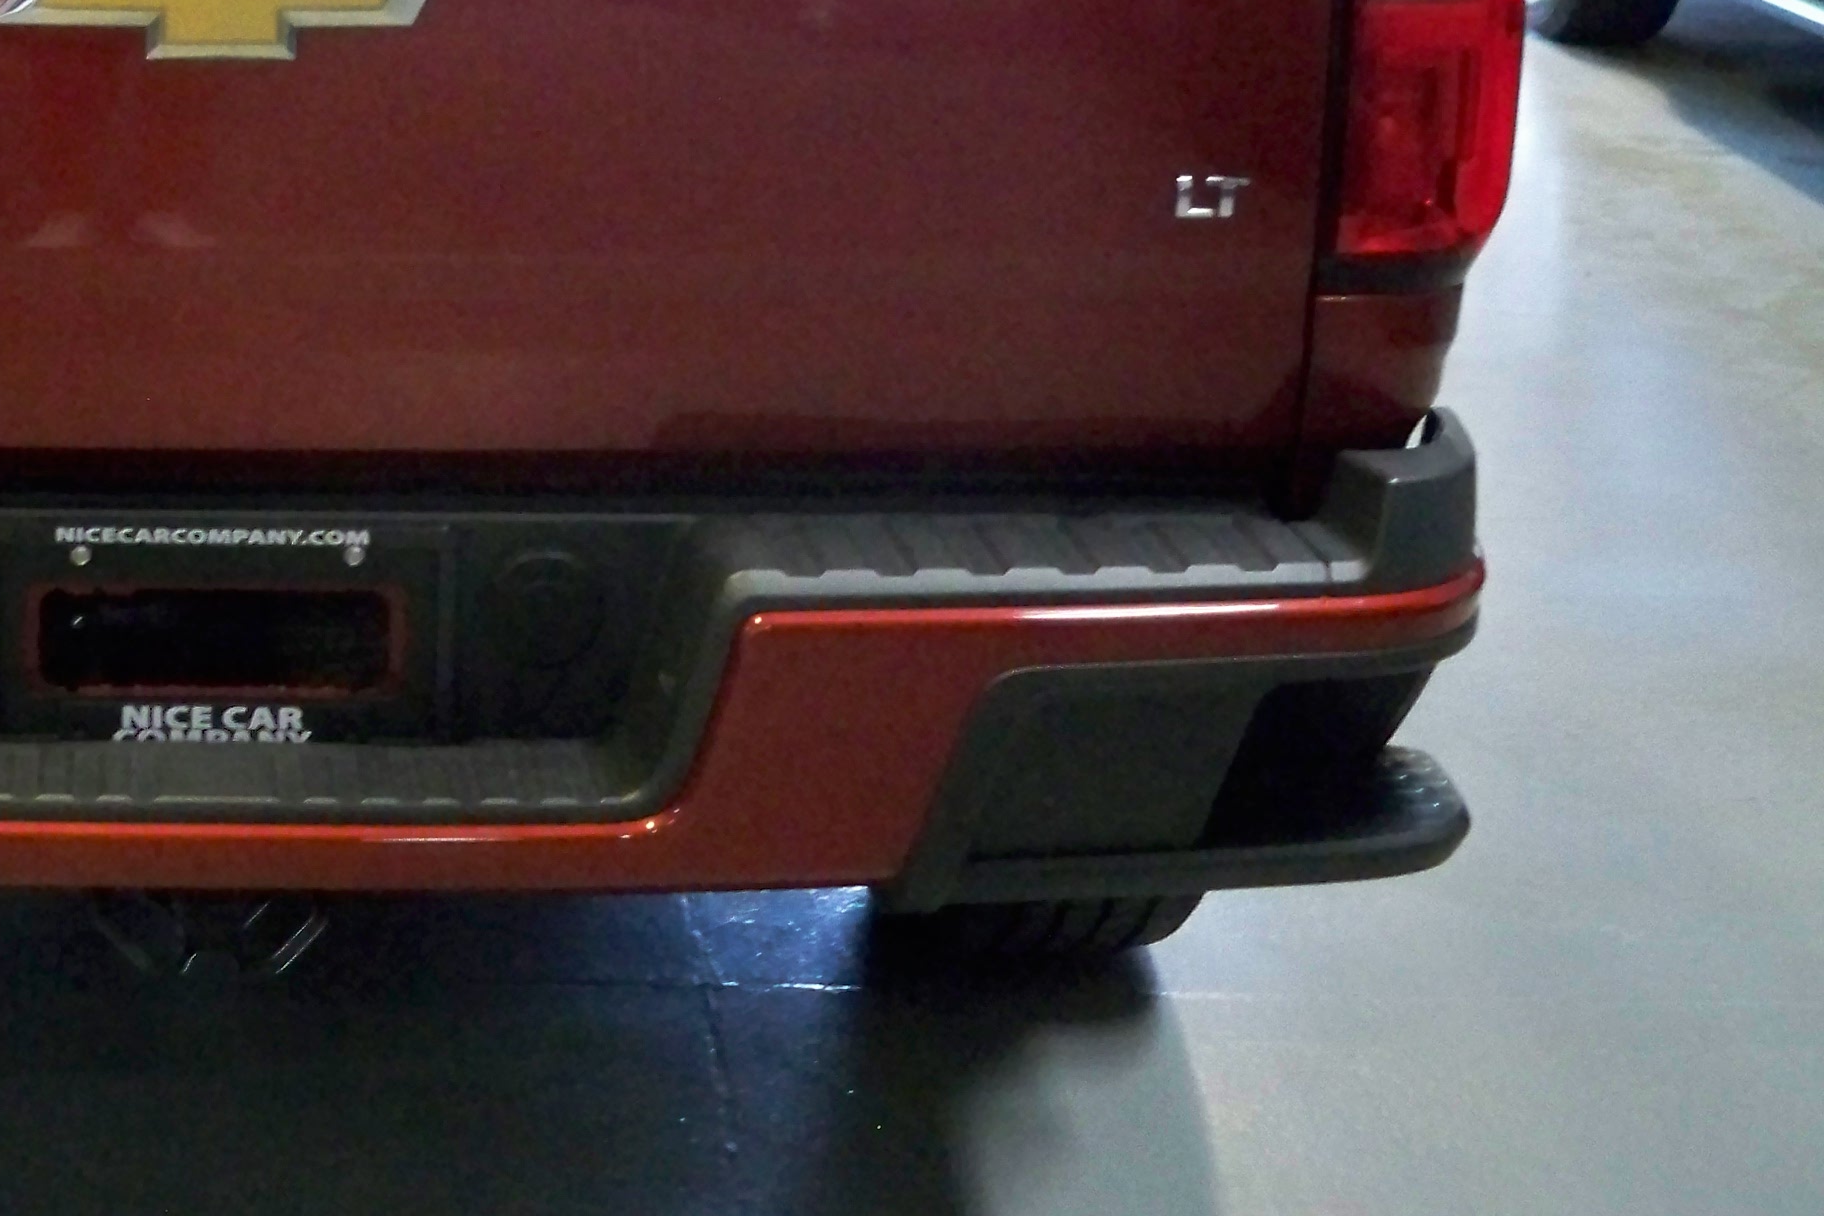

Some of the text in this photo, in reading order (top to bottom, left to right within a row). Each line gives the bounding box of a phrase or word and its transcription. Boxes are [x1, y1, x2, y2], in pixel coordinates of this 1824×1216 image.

[1175, 175, 1250, 218] LT
[55, 526, 370, 545] NICECARCOMPANY.COM
[122, 704, 303, 730] NICE CAR
